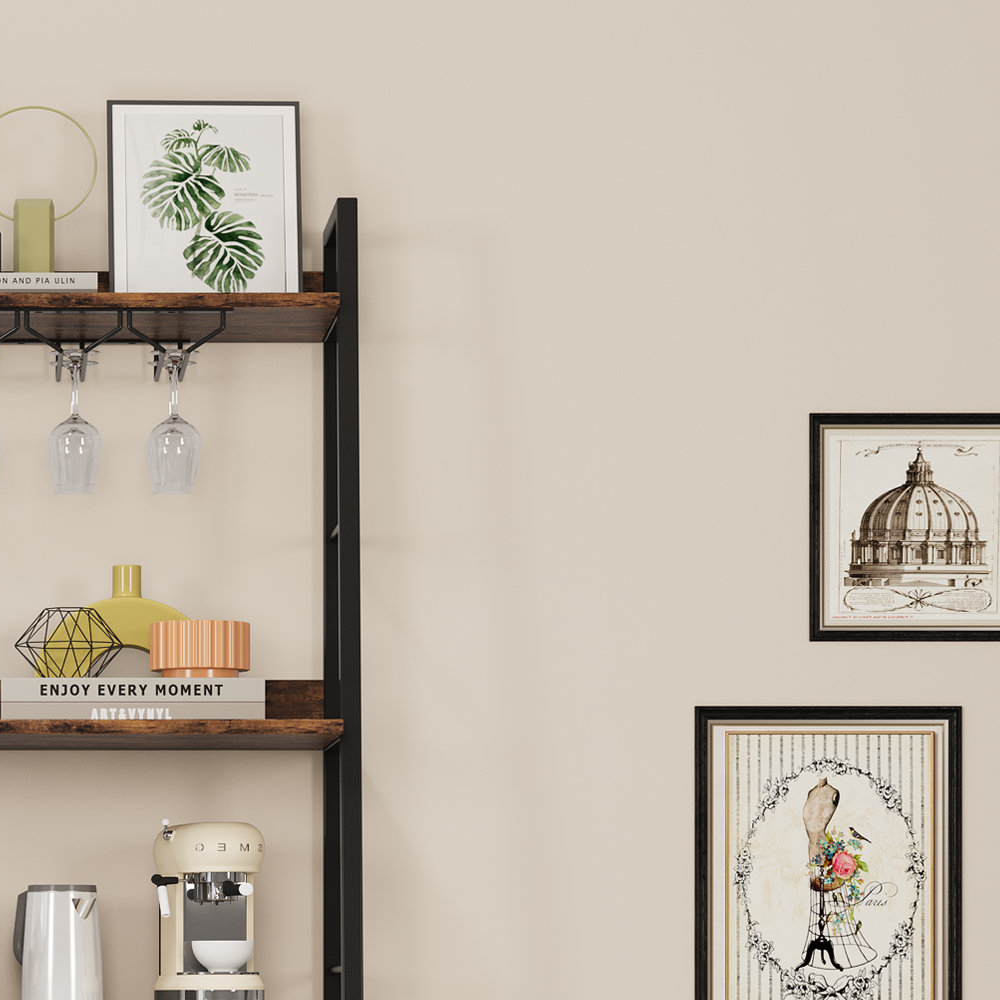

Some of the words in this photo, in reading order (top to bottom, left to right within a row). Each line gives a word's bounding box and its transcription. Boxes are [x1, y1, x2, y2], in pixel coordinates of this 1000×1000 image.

[12, 277, 32, 285] AND
[36, 277, 50, 285] PIA
[55, 277, 76, 285] ULIN
[40, 684, 91, 696] ENJOY
[98, 684, 148, 696] EVERY
[155, 684, 224, 696] MOMENT
[854, 880, 898, 906] Paris
